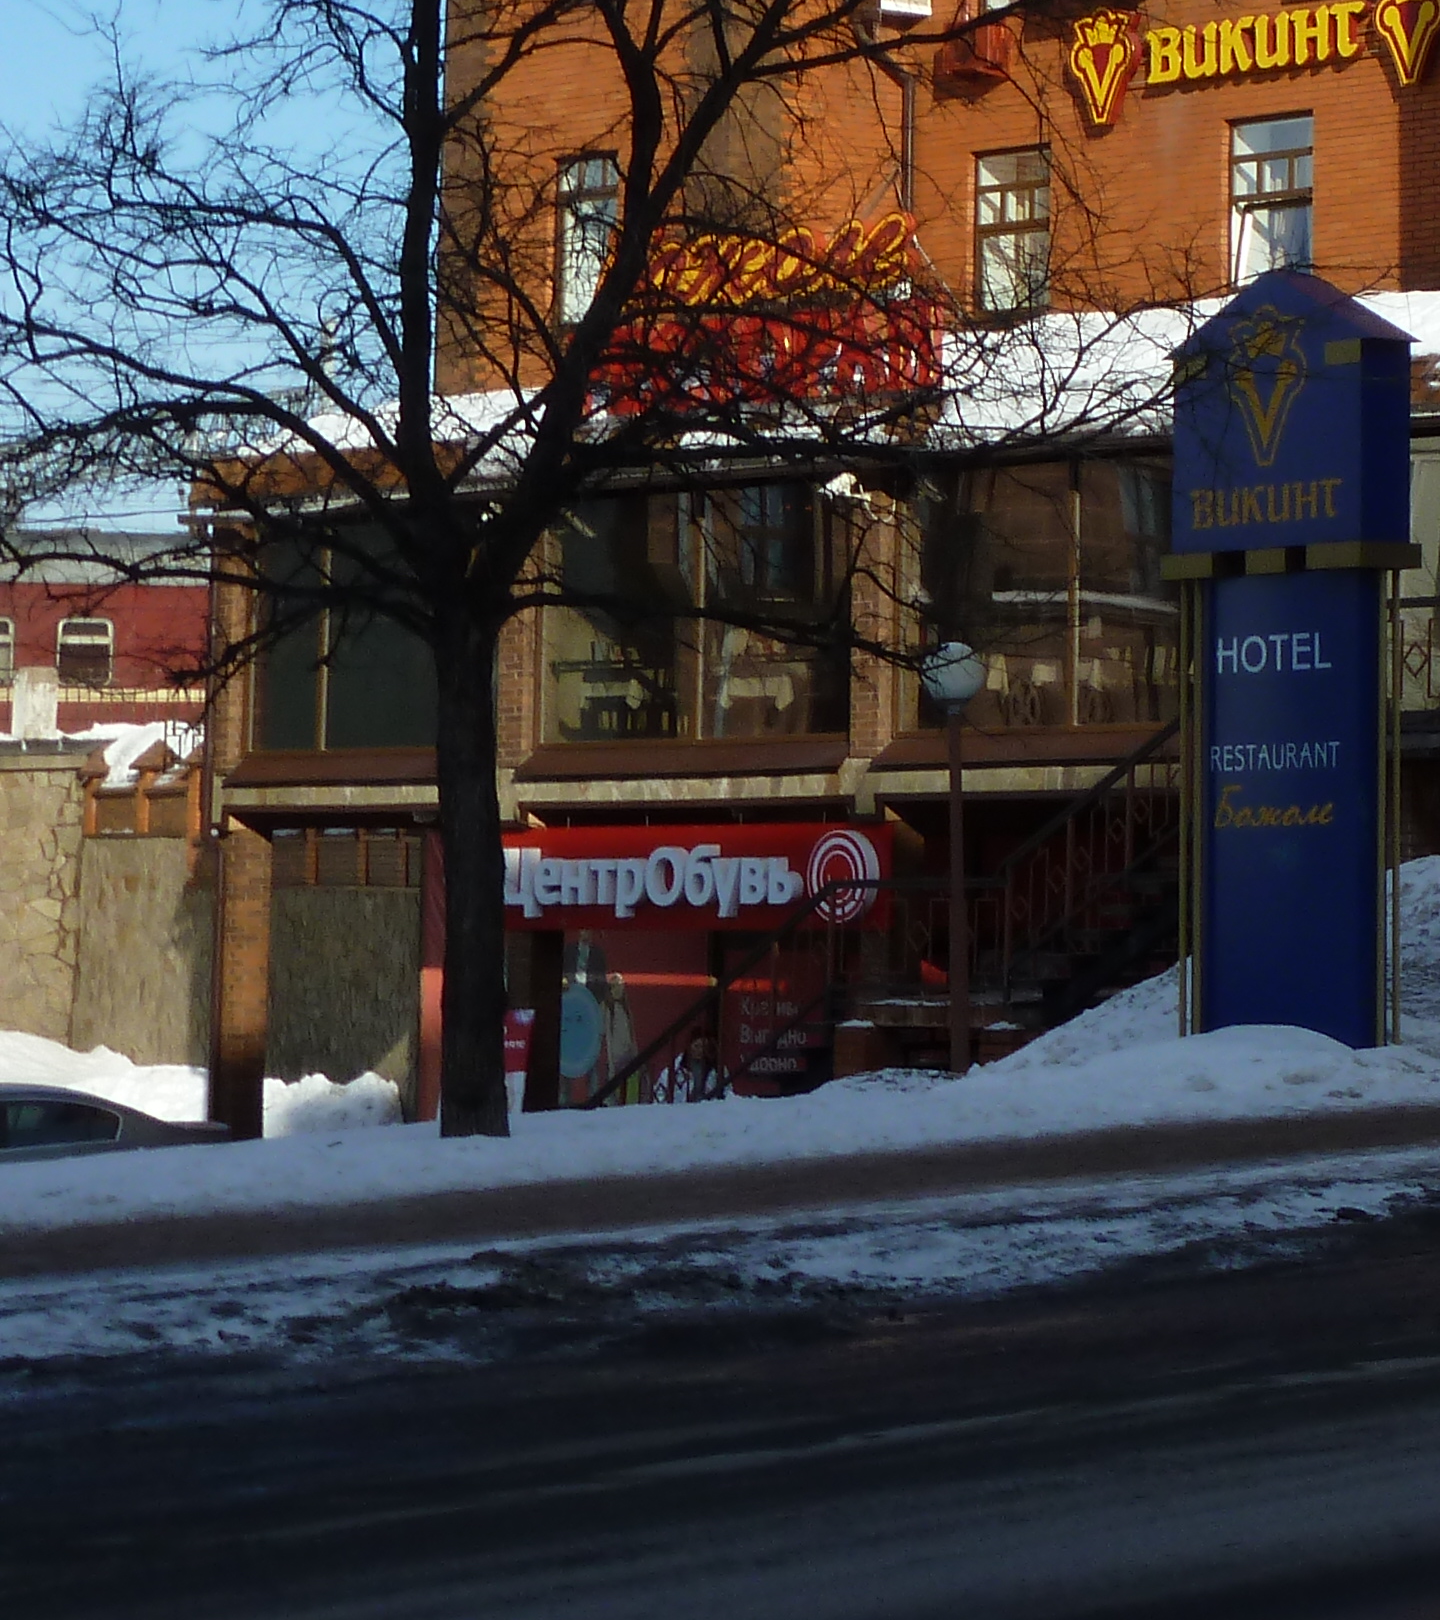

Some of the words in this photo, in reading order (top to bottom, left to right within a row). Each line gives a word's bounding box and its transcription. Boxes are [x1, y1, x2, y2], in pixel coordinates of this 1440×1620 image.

[1217, 630, 1332, 674] HOTEL
[1210, 741, 1340, 772] RESTAURANT
[1213, 784, 1335, 828] Божоле
[504, 843, 804, 918] ЦентрОбувь
